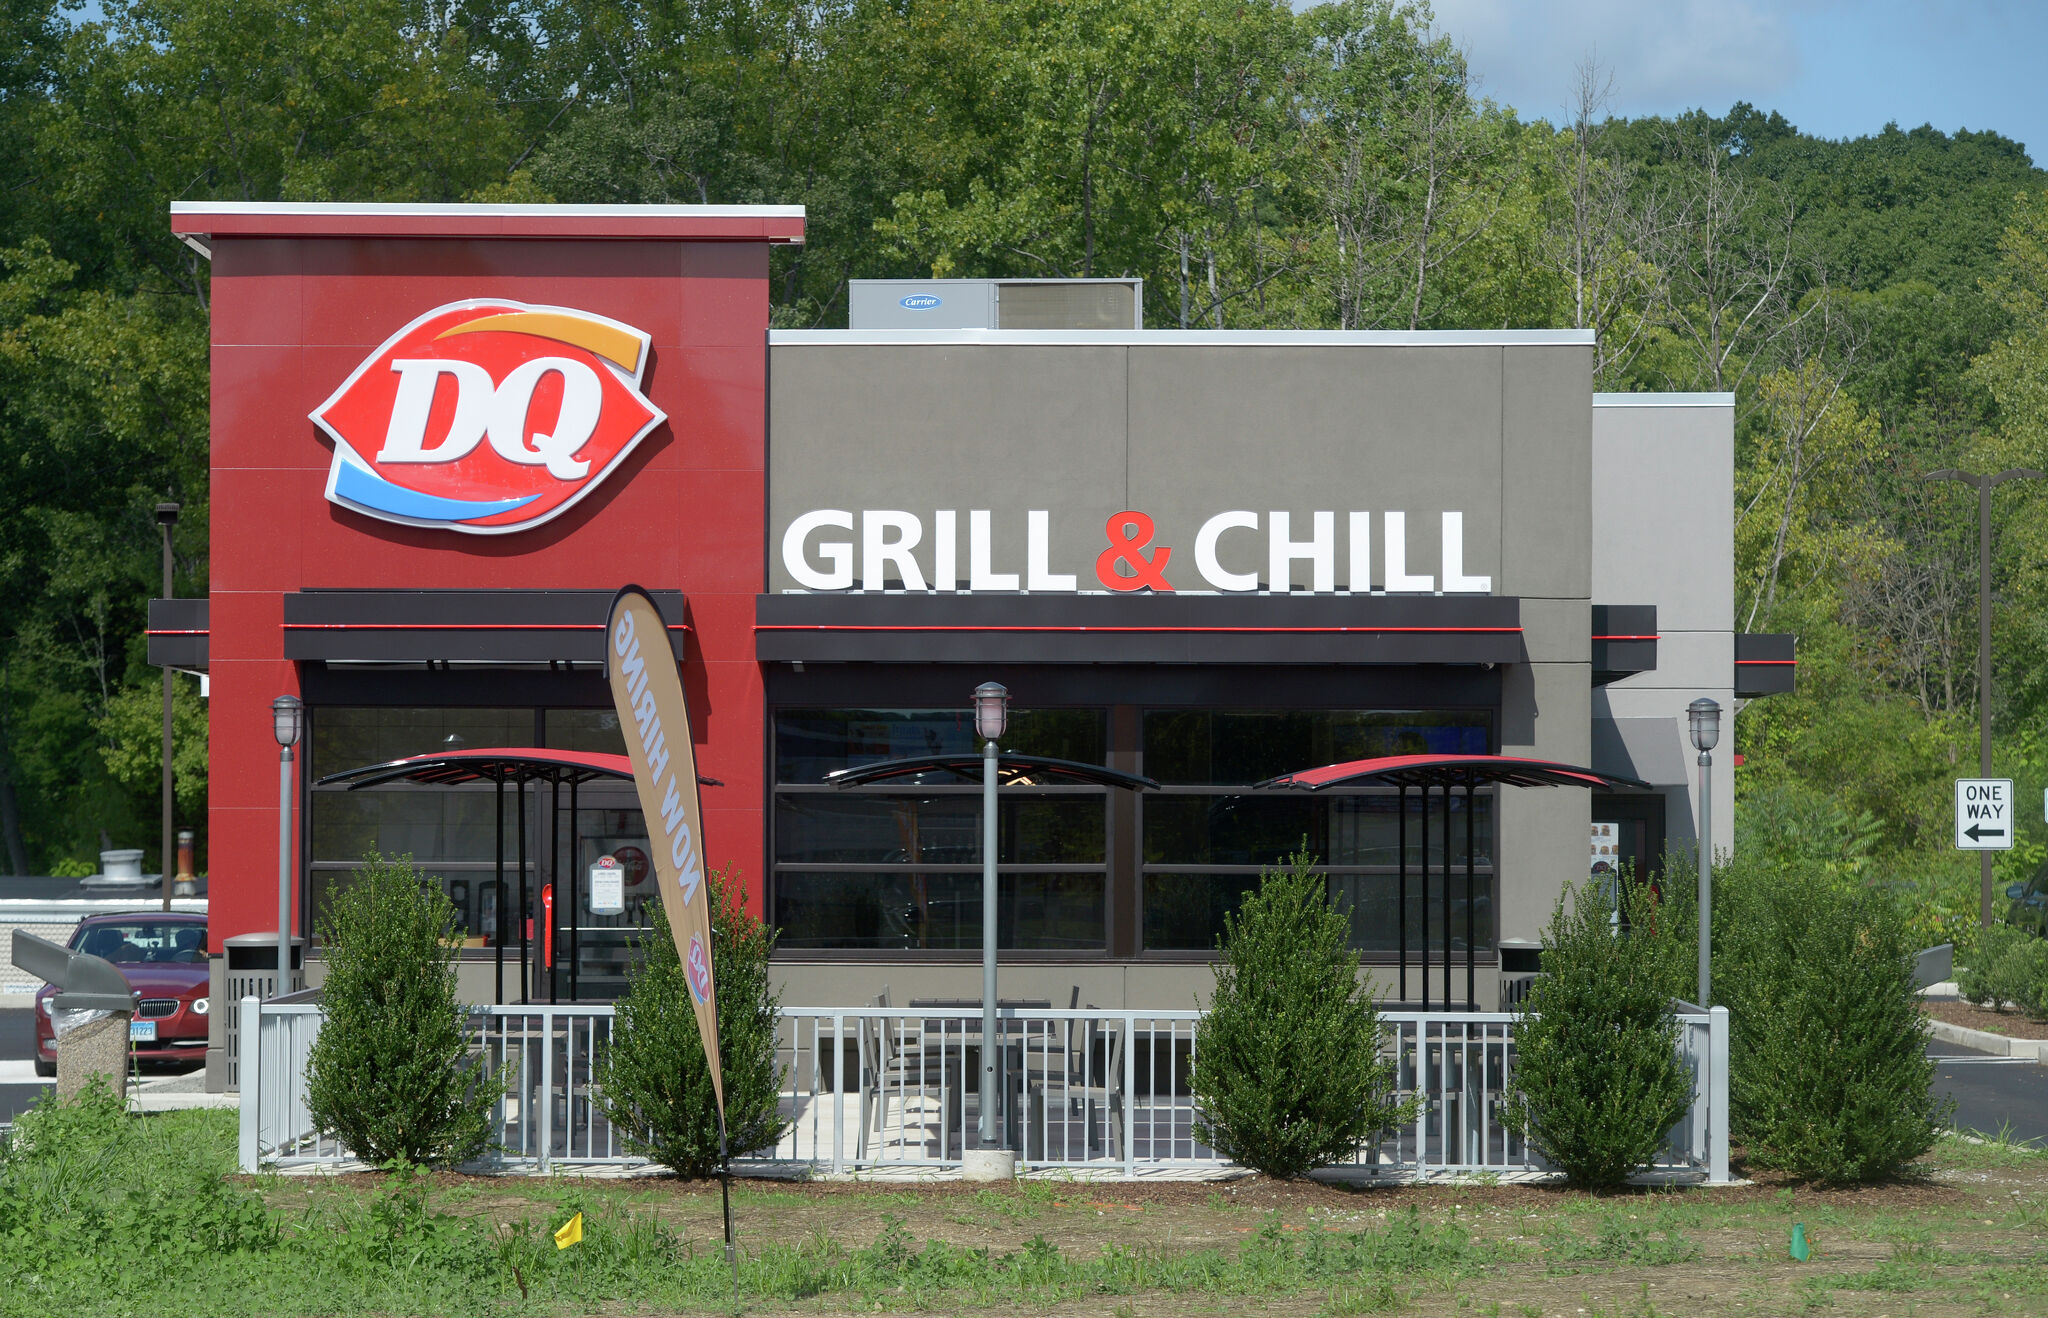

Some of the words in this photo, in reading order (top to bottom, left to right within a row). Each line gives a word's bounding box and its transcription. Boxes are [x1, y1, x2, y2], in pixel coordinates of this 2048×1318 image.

[905, 298, 937, 306] Carrier
[376, 356, 603, 480] DQ
[782, 510, 1077, 592] GRILL
[1095, 510, 1176, 592] &
[1194, 511, 1492, 593] CHILL
[1966, 785, 2002, 801] ONE
[1967, 804, 2004, 819] WAY
